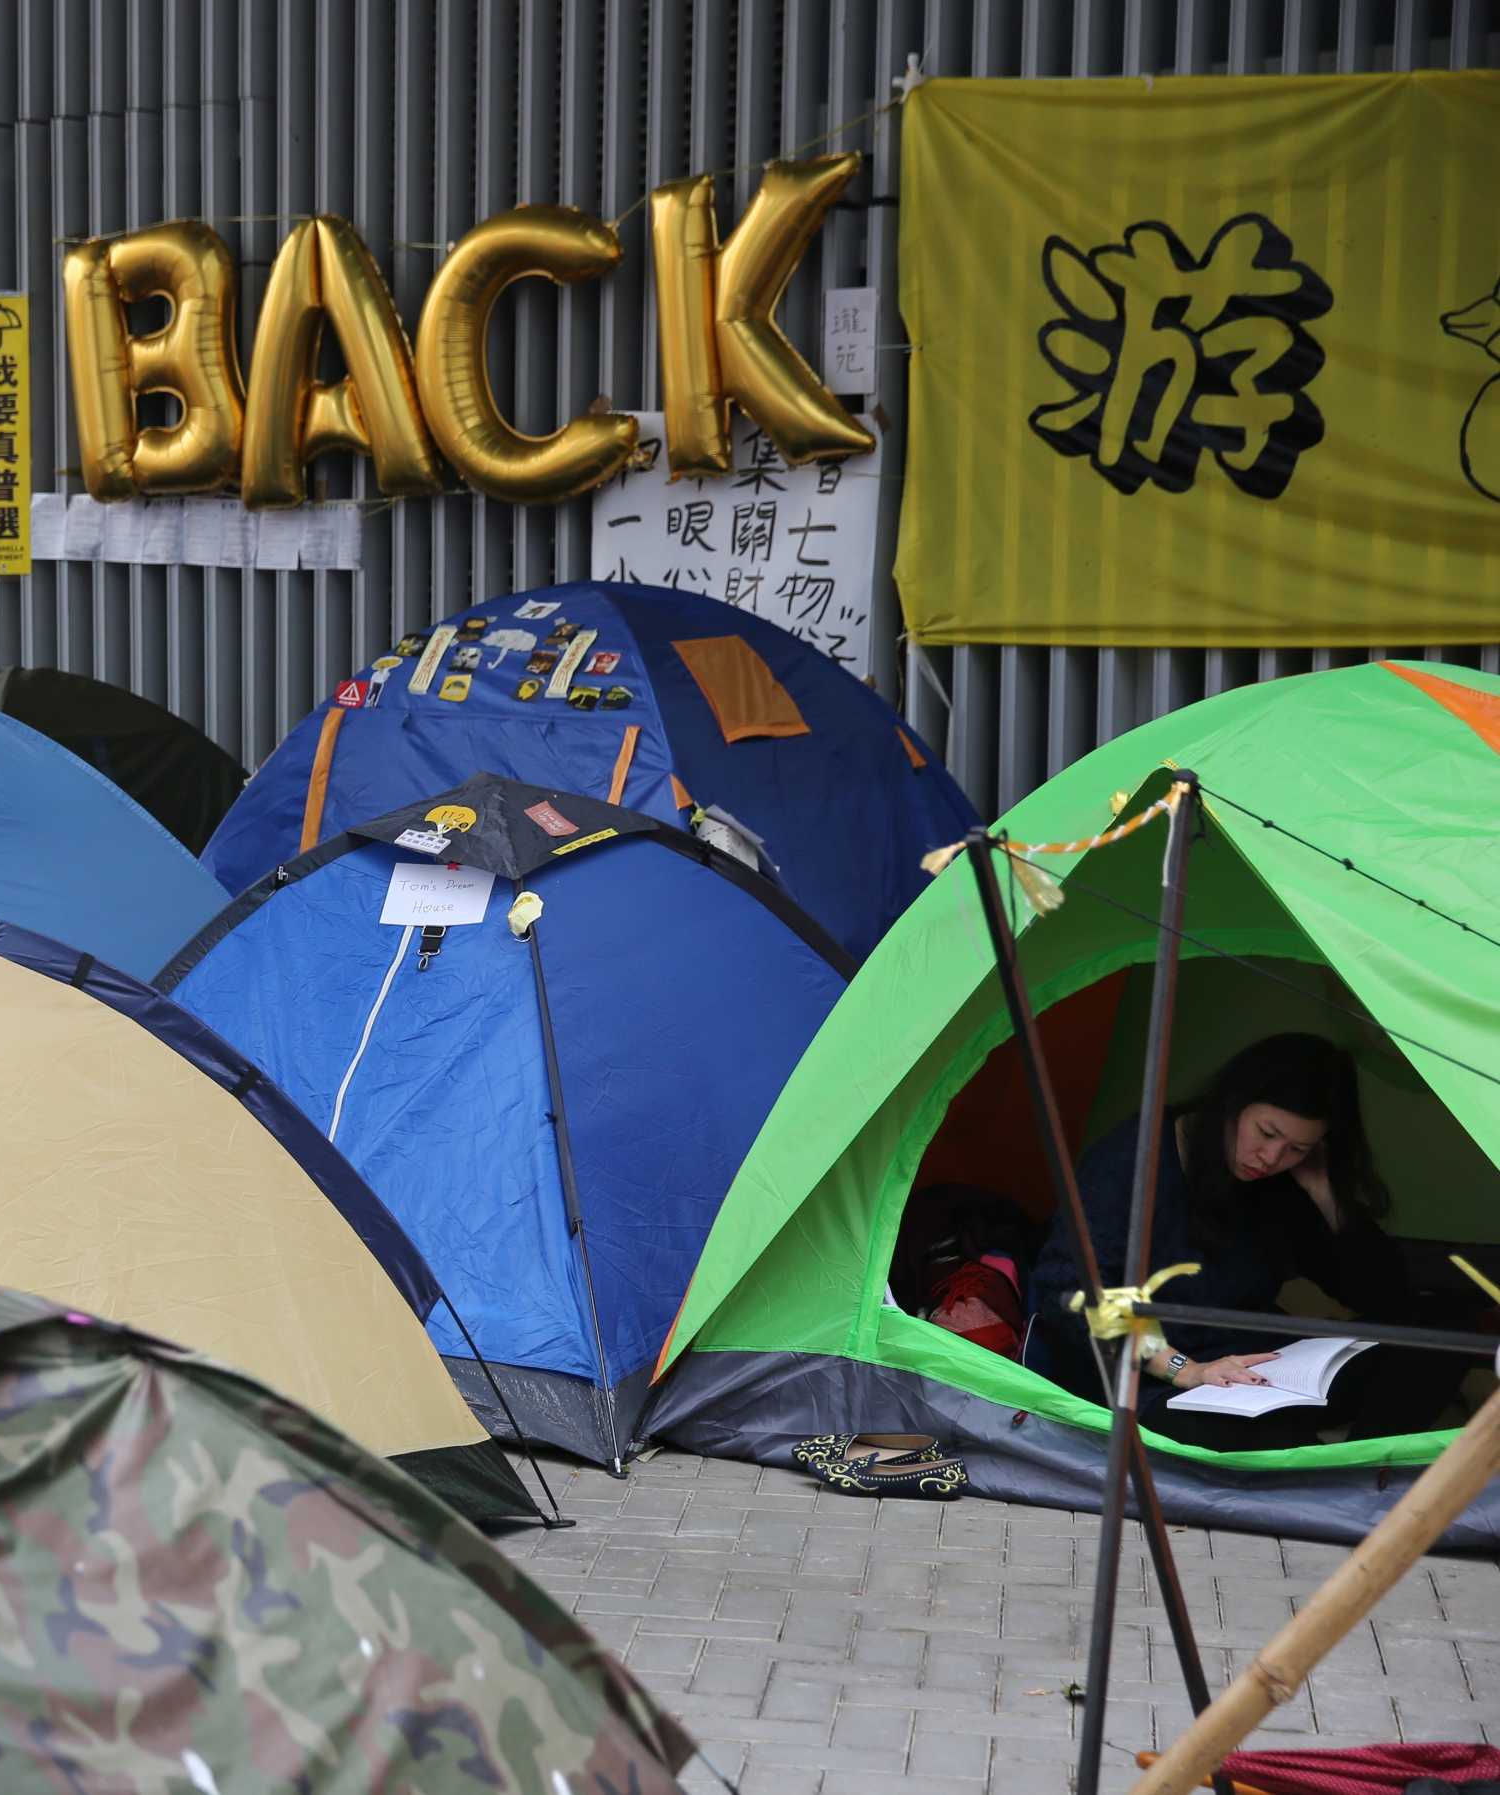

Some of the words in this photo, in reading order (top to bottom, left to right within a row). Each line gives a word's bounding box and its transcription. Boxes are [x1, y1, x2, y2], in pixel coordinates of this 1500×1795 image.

[64, 150, 877, 509] BACK
[1029, 213, 1332, 499] 游
[607, 499, 837, 567] 一眼關七
[397, 879, 437, 892] Tom's
[412, 898, 455, 913] House
